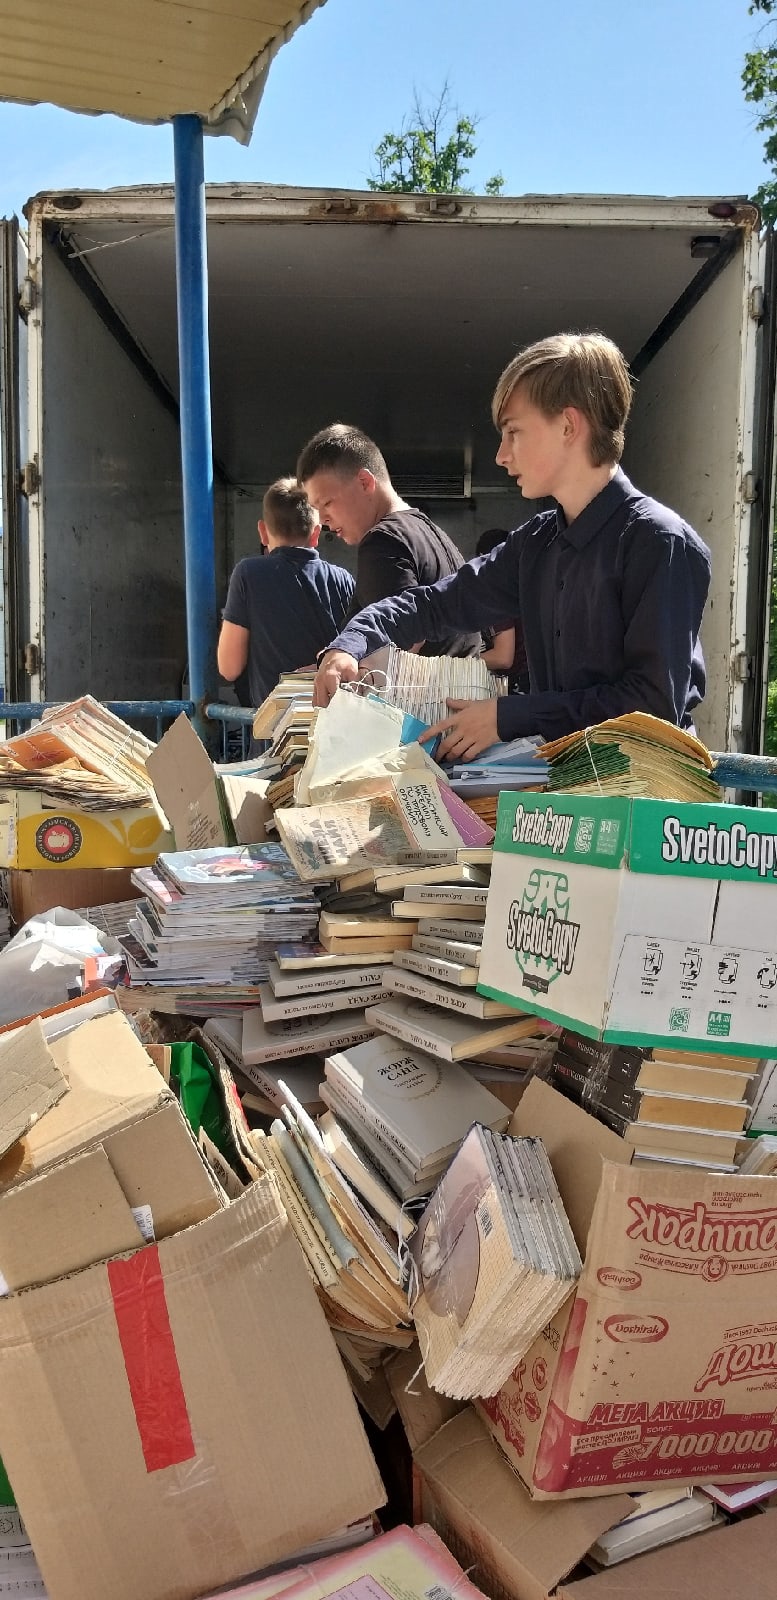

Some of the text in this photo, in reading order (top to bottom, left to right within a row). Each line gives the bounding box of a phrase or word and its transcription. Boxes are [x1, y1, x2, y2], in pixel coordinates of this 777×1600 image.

[512, 803, 575, 857] SvetoCopy
[506, 899, 581, 976] SvetoCopy
[347, 994, 370, 1004] САНД
[371, 991, 395, 1001] ЖОРЖ
[377, 1056, 415, 1076] ЖОРЖ
[387, 1063, 420, 1081] САНД
[626, 1197, 777, 1253] оширак
[614, 1323, 660, 1335] Doshirak
[587, 1399, 725, 1426] МЕГА АКЦИЯ
